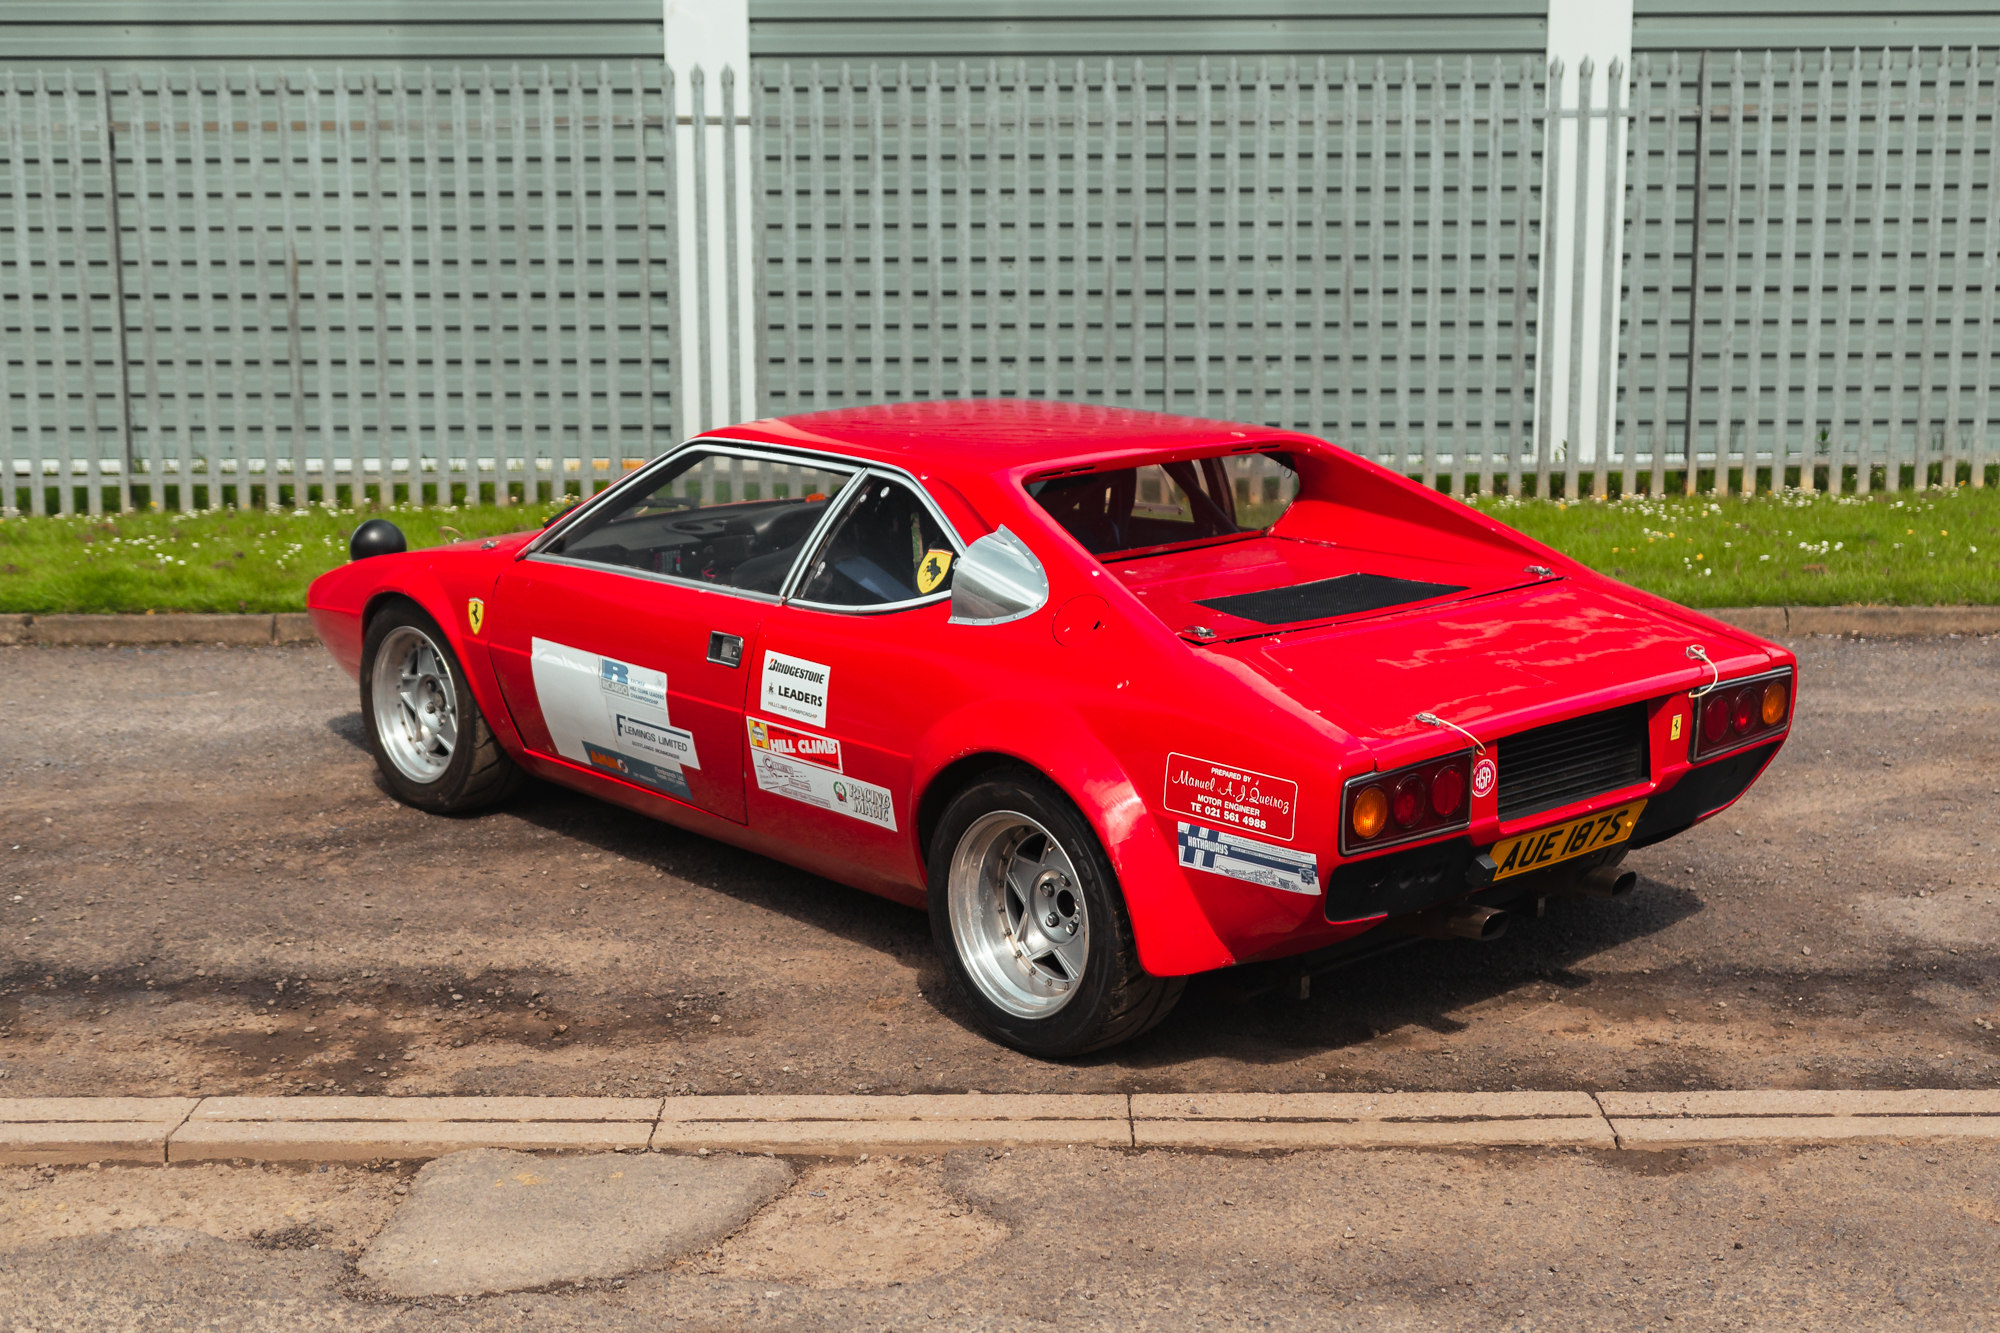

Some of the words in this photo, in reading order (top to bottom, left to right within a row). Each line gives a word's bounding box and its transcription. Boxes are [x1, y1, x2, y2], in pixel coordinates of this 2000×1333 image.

[768, 658, 825, 684] BRIDGESTONE
[602, 680, 628, 694] RICARDO
[649, 691, 665, 700] LEADERS
[778, 685, 823, 707] LEADERS
[630, 693, 658, 705] CHAMPIONSHIP
[768, 701, 787, 711] HILLCLIMB
[788, 706, 818, 719] CHAMPIONSHIP
[616, 713, 656, 742] FLEMINGS
[658, 735, 688, 752] LIMITED
[769, 739, 796, 753] HILL
[798, 739, 837, 755] CLIMB
[1172, 770, 1215, 792] Manuel
[1211, 767, 1241, 780] PREPARED
[1243, 775, 1251, 783] BY
[1476, 767, 1491, 789] HSA
[846, 782, 890, 809] RACING
[1197, 794, 1222, 807] MOTOR
[1224, 801, 1260, 816] ENGINEER
[852, 799, 889, 822] MAGIC
[1190, 802, 1202, 813] TE
[1205, 806, 1221, 818] 021
[1223, 811, 1239, 823] 561
[1242, 816, 1267, 830] 4988
[1187, 835, 1229, 856] HATHAWAYS
[1498, 829, 1564, 874] AUE
[1560, 810, 1629, 856] 187S
